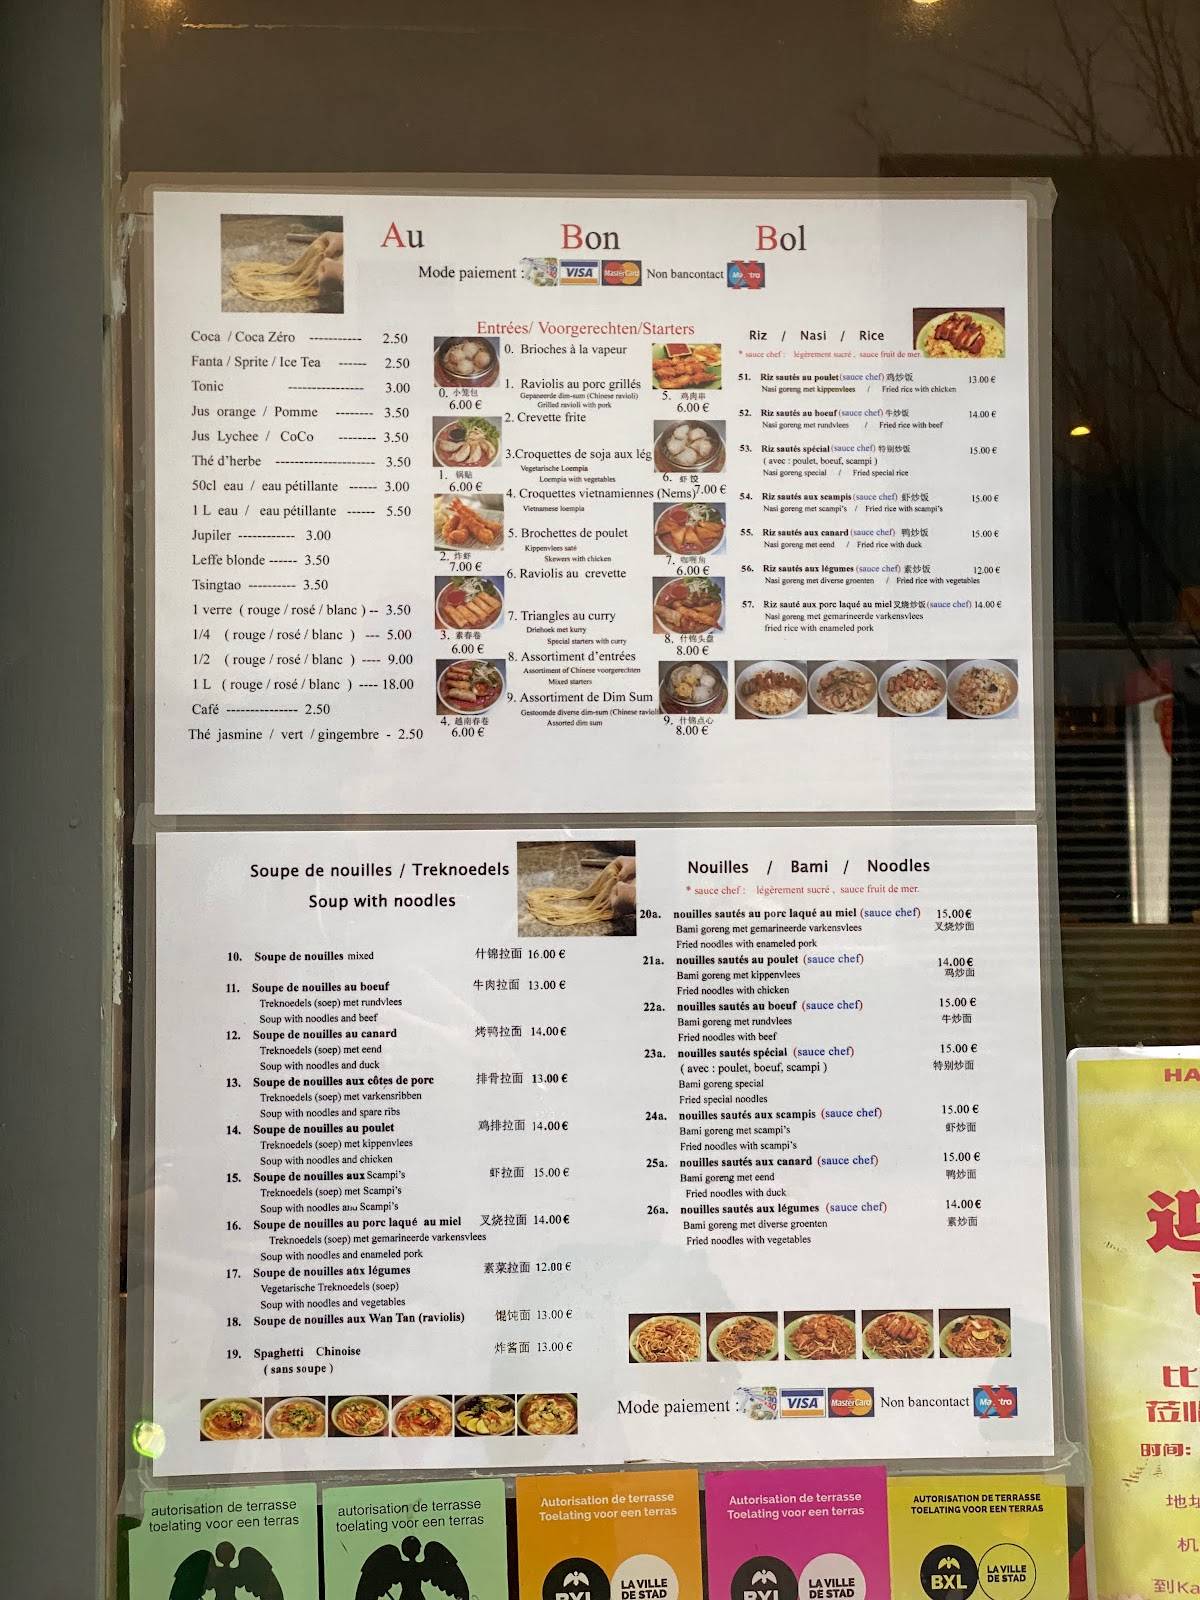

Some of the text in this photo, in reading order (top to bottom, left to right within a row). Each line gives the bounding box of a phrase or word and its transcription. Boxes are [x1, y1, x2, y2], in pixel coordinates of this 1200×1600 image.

[381, 222, 807, 251] Au Bon Bol
[749, 330, 767, 340] Riz
[800, 330, 826, 341] Nasi
[859, 330, 884, 341] Rice
[504, 344, 627, 357] 0. Brioches à la vapeur
[191, 380, 410, 393] Tonic 3.00
[506, 378, 641, 394] 1. Raviolis au porc grillés
[192, 529, 331, 543] Jupiler 3.00
[508, 527, 628, 540] 5. Brochettes de poulet
[192, 554, 330, 566] Leffe blonde 3.50
[506, 569, 516, 579] 6.
[520, 568, 563, 578] Raviolis
[585, 570, 626, 578] crevette
[763, 564, 775, 572] Riz
[777, 564, 803, 572] sautés
[822, 564, 854, 574] légumes
[855, 564, 879, 573] (sauce
[881, 564, 901, 573] chef)
[974, 566, 994, 575] 12.00
[192, 579, 328, 593] Tsingtao 3.50
[765, 624, 874, 633] fried rice with enameled pork
[547, 638, 570, 646] Special
[451, 644, 474, 654] 6.00
[192, 704, 330, 715] Café 2.50
[664, 715, 674, 726] 9.
[676, 725, 699, 735] 8.00
[250, 864, 299, 880] Soupe
[305, 863, 324, 877] de
[331, 863, 392, 877] nouilles
[412, 862, 509, 876] Treknoedels
[688, 860, 749, 874] Nouilles
[791, 860, 828, 873] Bami
[868, 858, 930, 872] Noodles
[309, 893, 456, 911] Soup with noodles
[643, 955, 664, 965] 21a.
[676, 955, 715, 965] nouilles
[718, 955, 749, 964] sautés
[767, 954, 798, 966] poulet
[803, 955, 835, 965] (sauce
[838, 953, 864, 964] chef)
[227, 983, 240, 993] 11.
[252, 983, 284, 995] Soupe
[286, 982, 299, 992] de
[302, 982, 341, 992] nouilles
[360, 981, 390, 991] boeuf
[529, 980, 556, 990] 13.00
[687, 1235, 811, 1246] Fried noodles with vegetables
[227, 1349, 241, 1359] 19.
[254, 1347, 304, 1360] Spaghetti
[316, 1346, 361, 1356] Chinoise
[538, 1342, 564, 1352] 13.00
[617, 1399, 659, 1414] Mode
[664, 1398, 730, 1417] paiement
[785, 1396, 818, 1409] VISA
[831, 1398, 871, 1407] MasterCard
[880, 1397, 904, 1408] Non
[907, 1396, 970, 1408] bancontact
[541, 1494, 674, 1507] Autorisation de terrasse
[913, 1493, 1041, 1503] AUTORISATION DE TERRASSE
[151, 1501, 297, 1517] autorisation de terrasse
[539, 1507, 677, 1522] Toelating voor een terras
[910, 1504, 1043, 1514] TOELATING VOOR EEN TERRAS
[149, 1516, 299, 1533] toelating voor een terras
[987, 1564, 1027, 1573] LA VILLE
[931, 1575, 967, 1590] BXL
[987, 1574, 1026, 1583] DE STAD
